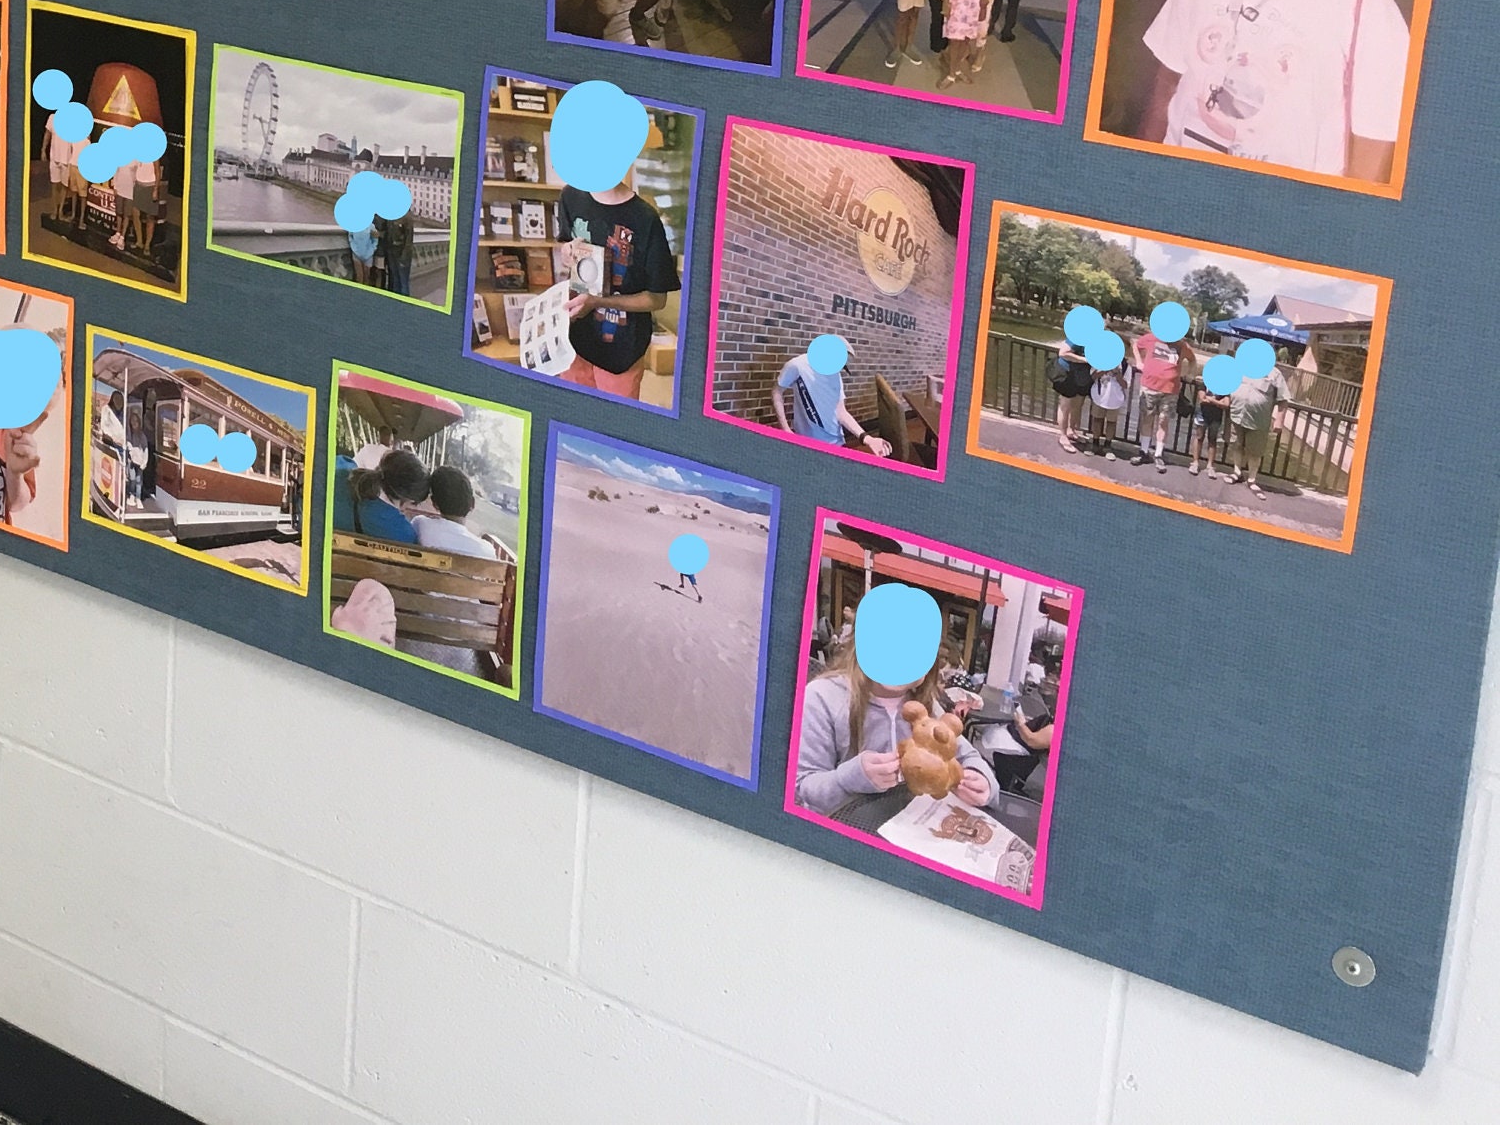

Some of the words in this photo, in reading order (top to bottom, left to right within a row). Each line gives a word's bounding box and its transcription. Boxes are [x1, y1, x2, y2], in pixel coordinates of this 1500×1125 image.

[821, 166, 893, 245] Hard
[891, 216, 930, 267] Rock
[831, 293, 917, 331] PITTSBURGH
[190, 478, 207, 490] 22
